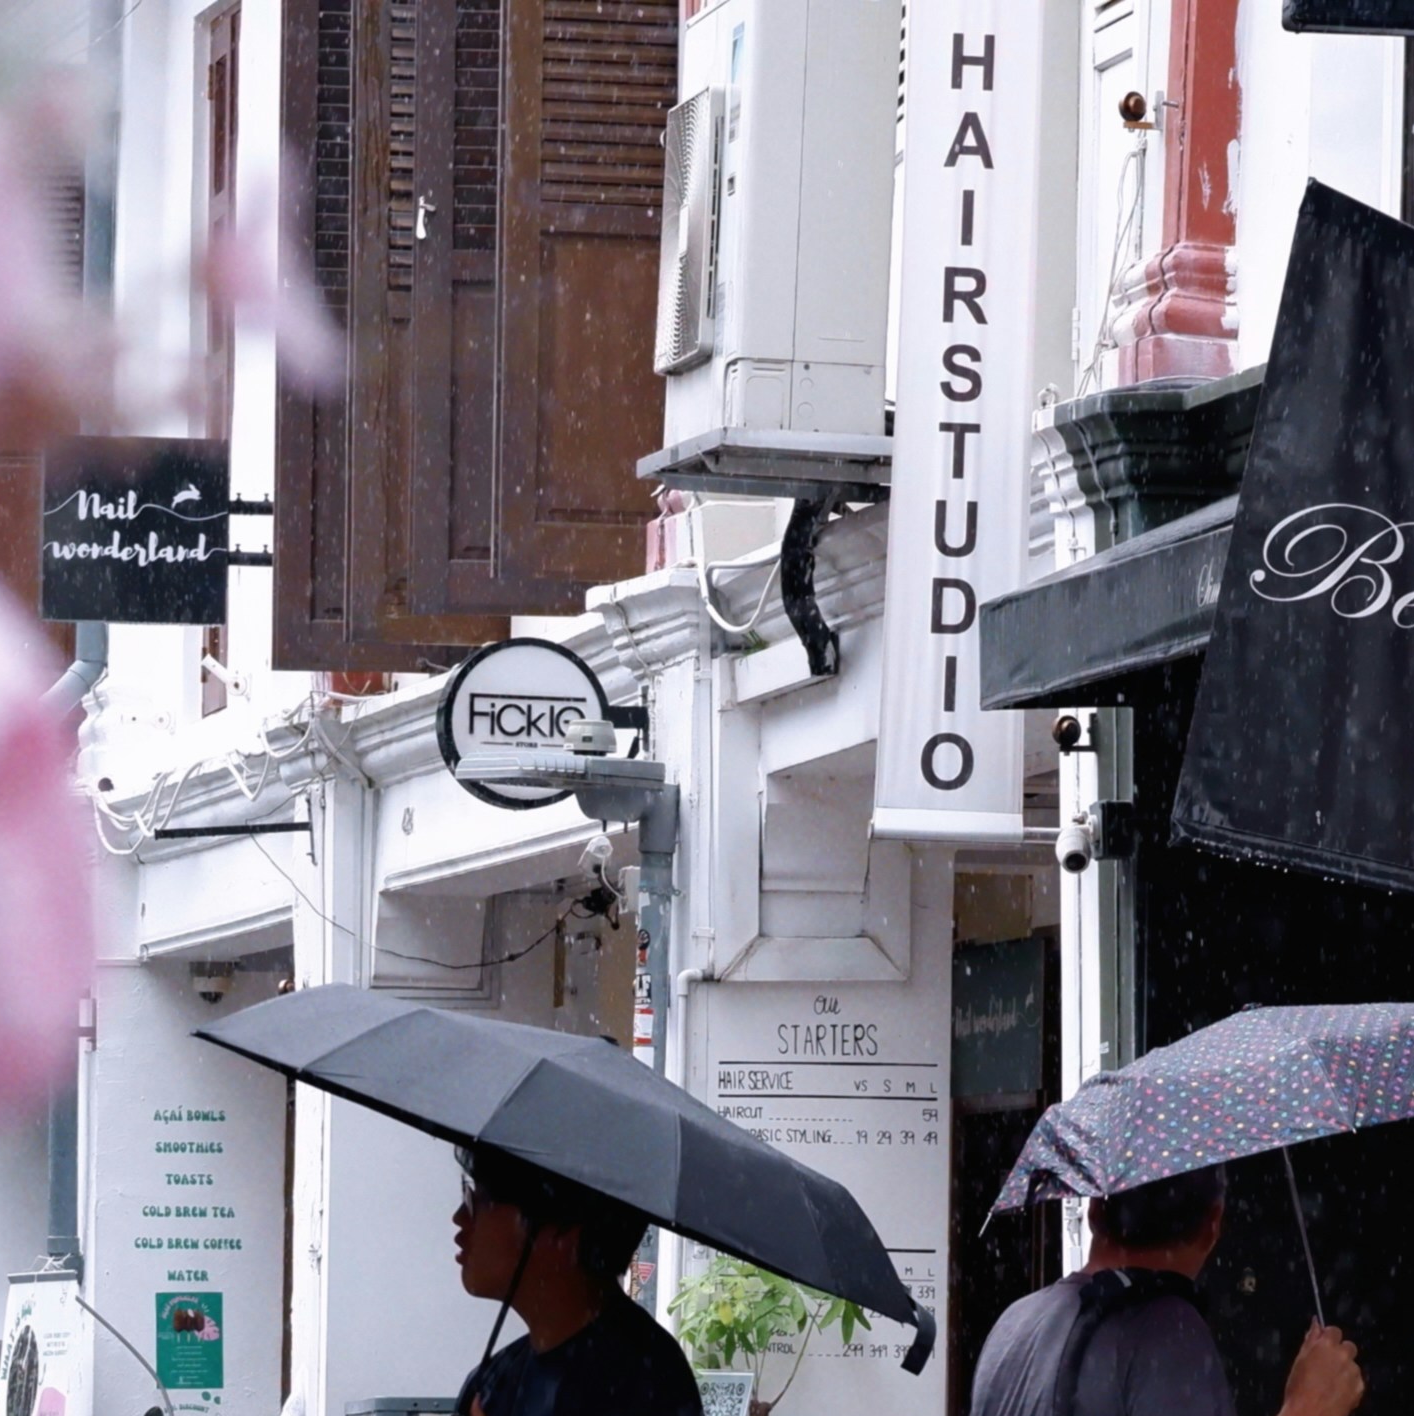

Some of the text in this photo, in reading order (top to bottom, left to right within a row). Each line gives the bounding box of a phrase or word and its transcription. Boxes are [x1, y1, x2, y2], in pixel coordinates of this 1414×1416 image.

[75, 489, 143, 521] Nail
[46, 530, 215, 568] wonderland
[777, 1022, 880, 1057] STARTERS
[717, 1070, 938, 1094] HAIR SERVICE VS S M L
[186, 1109, 227, 1122] BOWLS
[717, 1105, 939, 1122] HAIRCUT 59
[786, 1127, 833, 1144] STYLING
[856, 1130, 869, 1145] 19
[876, 1130, 893, 1145] 29
[899, 1130, 916, 1146] 39
[922, 1131, 939, 1146] 49
[164, 1172, 214, 1186] TOASTS
[141, 1205, 236, 1219] COLD BREW TEA
[134, 1236, 243, 1251] COLD BREW COFFEE
[166, 1269, 210, 1283] WATER
[904, 1266, 935, 1277] M L
[868, 1343, 889, 1358] 349
